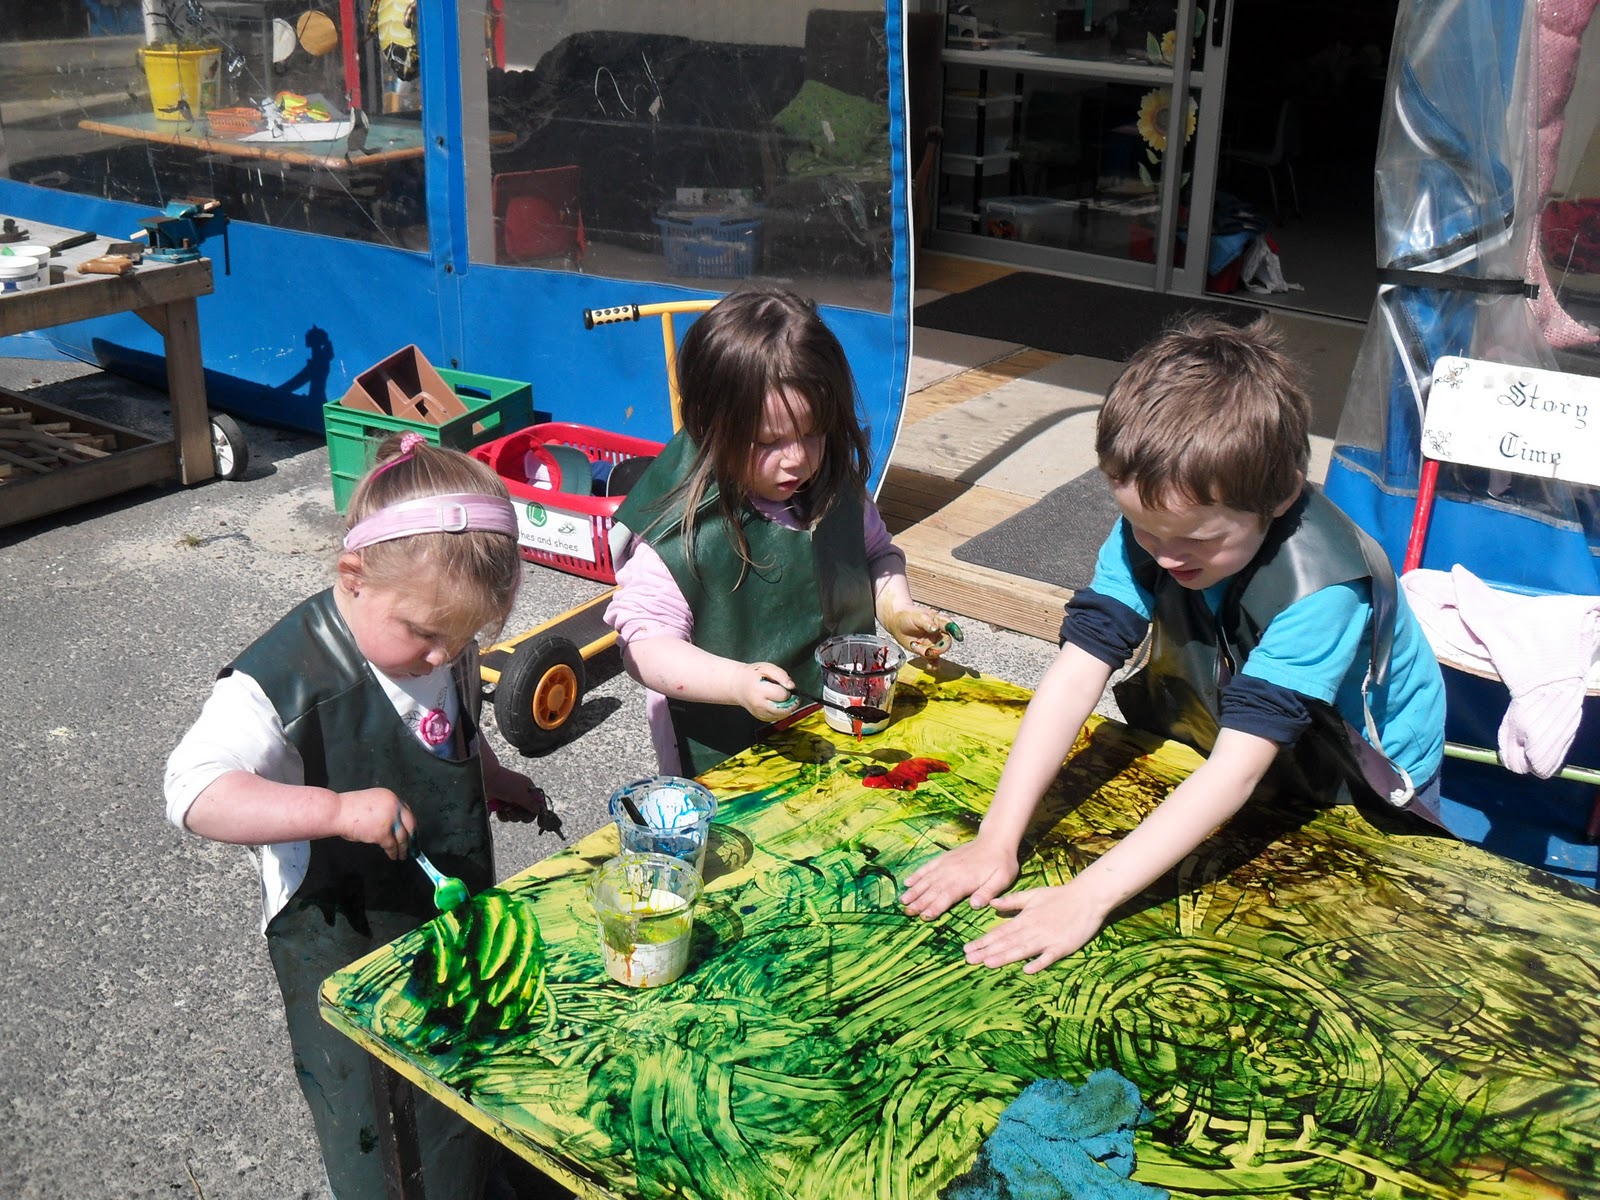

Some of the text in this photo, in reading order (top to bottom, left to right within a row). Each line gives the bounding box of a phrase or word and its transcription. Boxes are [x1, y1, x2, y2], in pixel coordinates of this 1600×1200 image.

[1497, 380, 1588, 430] Story
[1499, 431, 1561, 466] Time
[519, 530, 578, 551] hes and shoes
